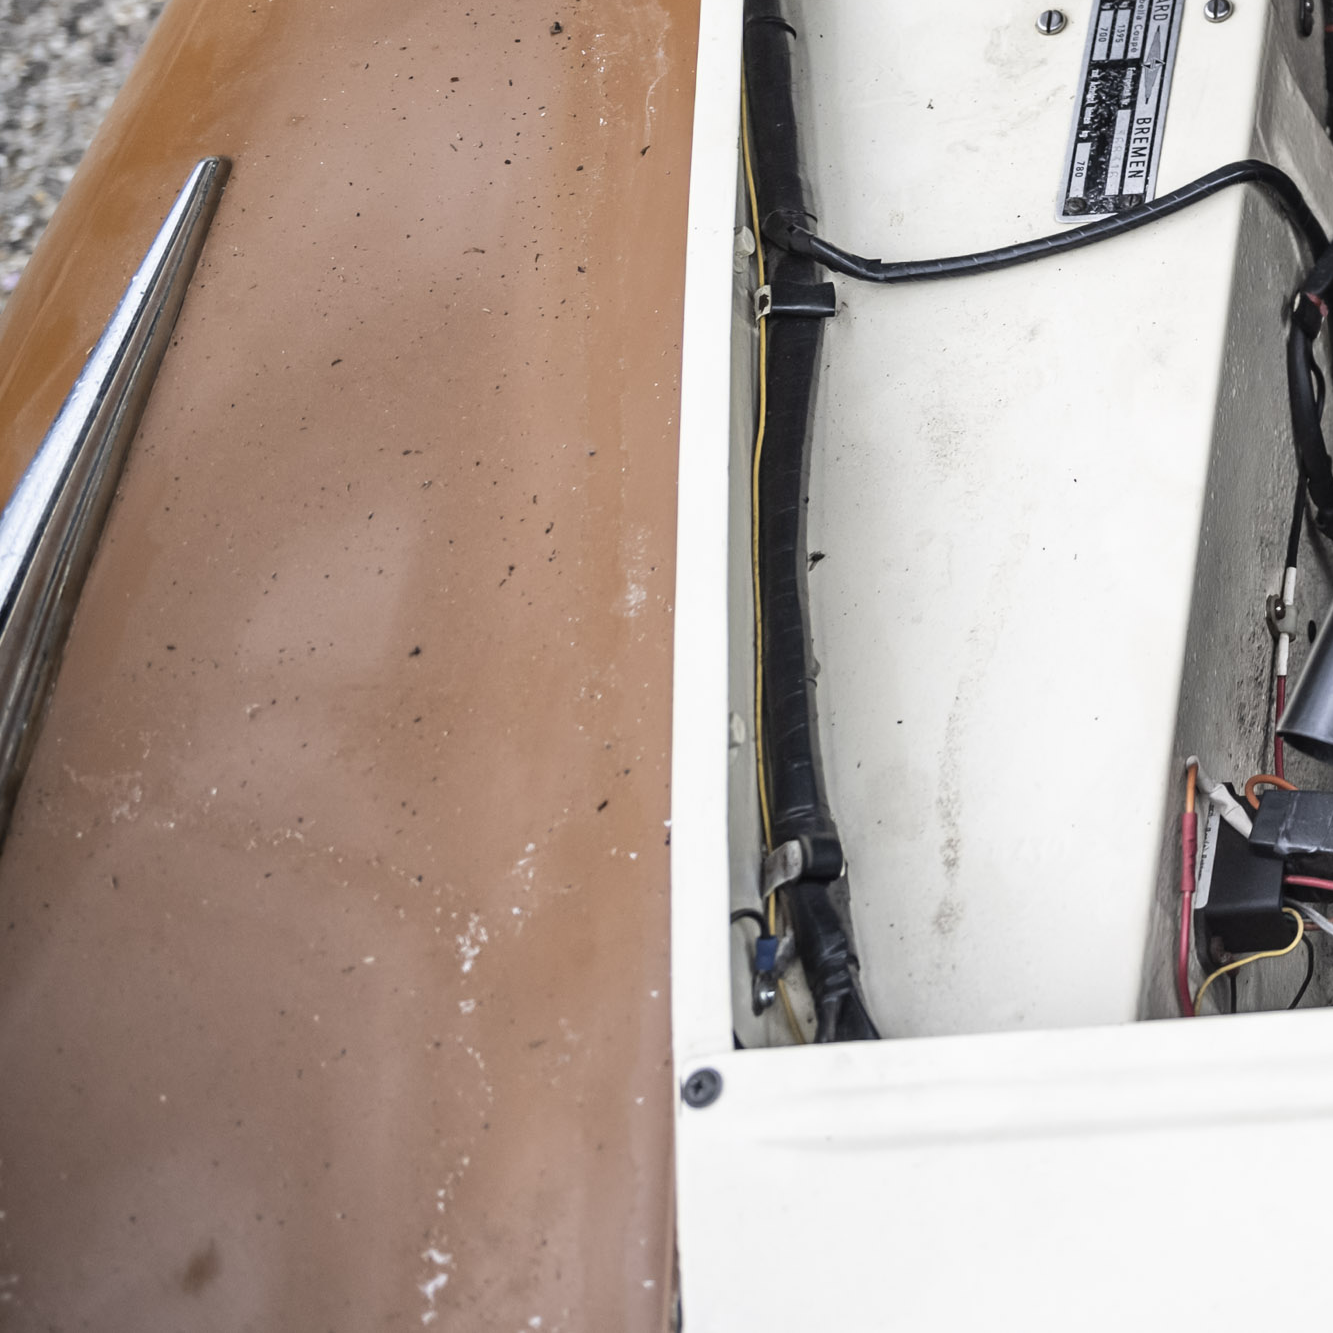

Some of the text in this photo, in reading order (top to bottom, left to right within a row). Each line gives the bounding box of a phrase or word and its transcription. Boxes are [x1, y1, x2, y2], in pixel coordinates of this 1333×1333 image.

[1097, 26, 1109, 42] 700
[1114, 24, 1126, 43] 1395
[1126, 116, 1152, 178] BREMEN
[1073, 161, 1085, 178] 780
